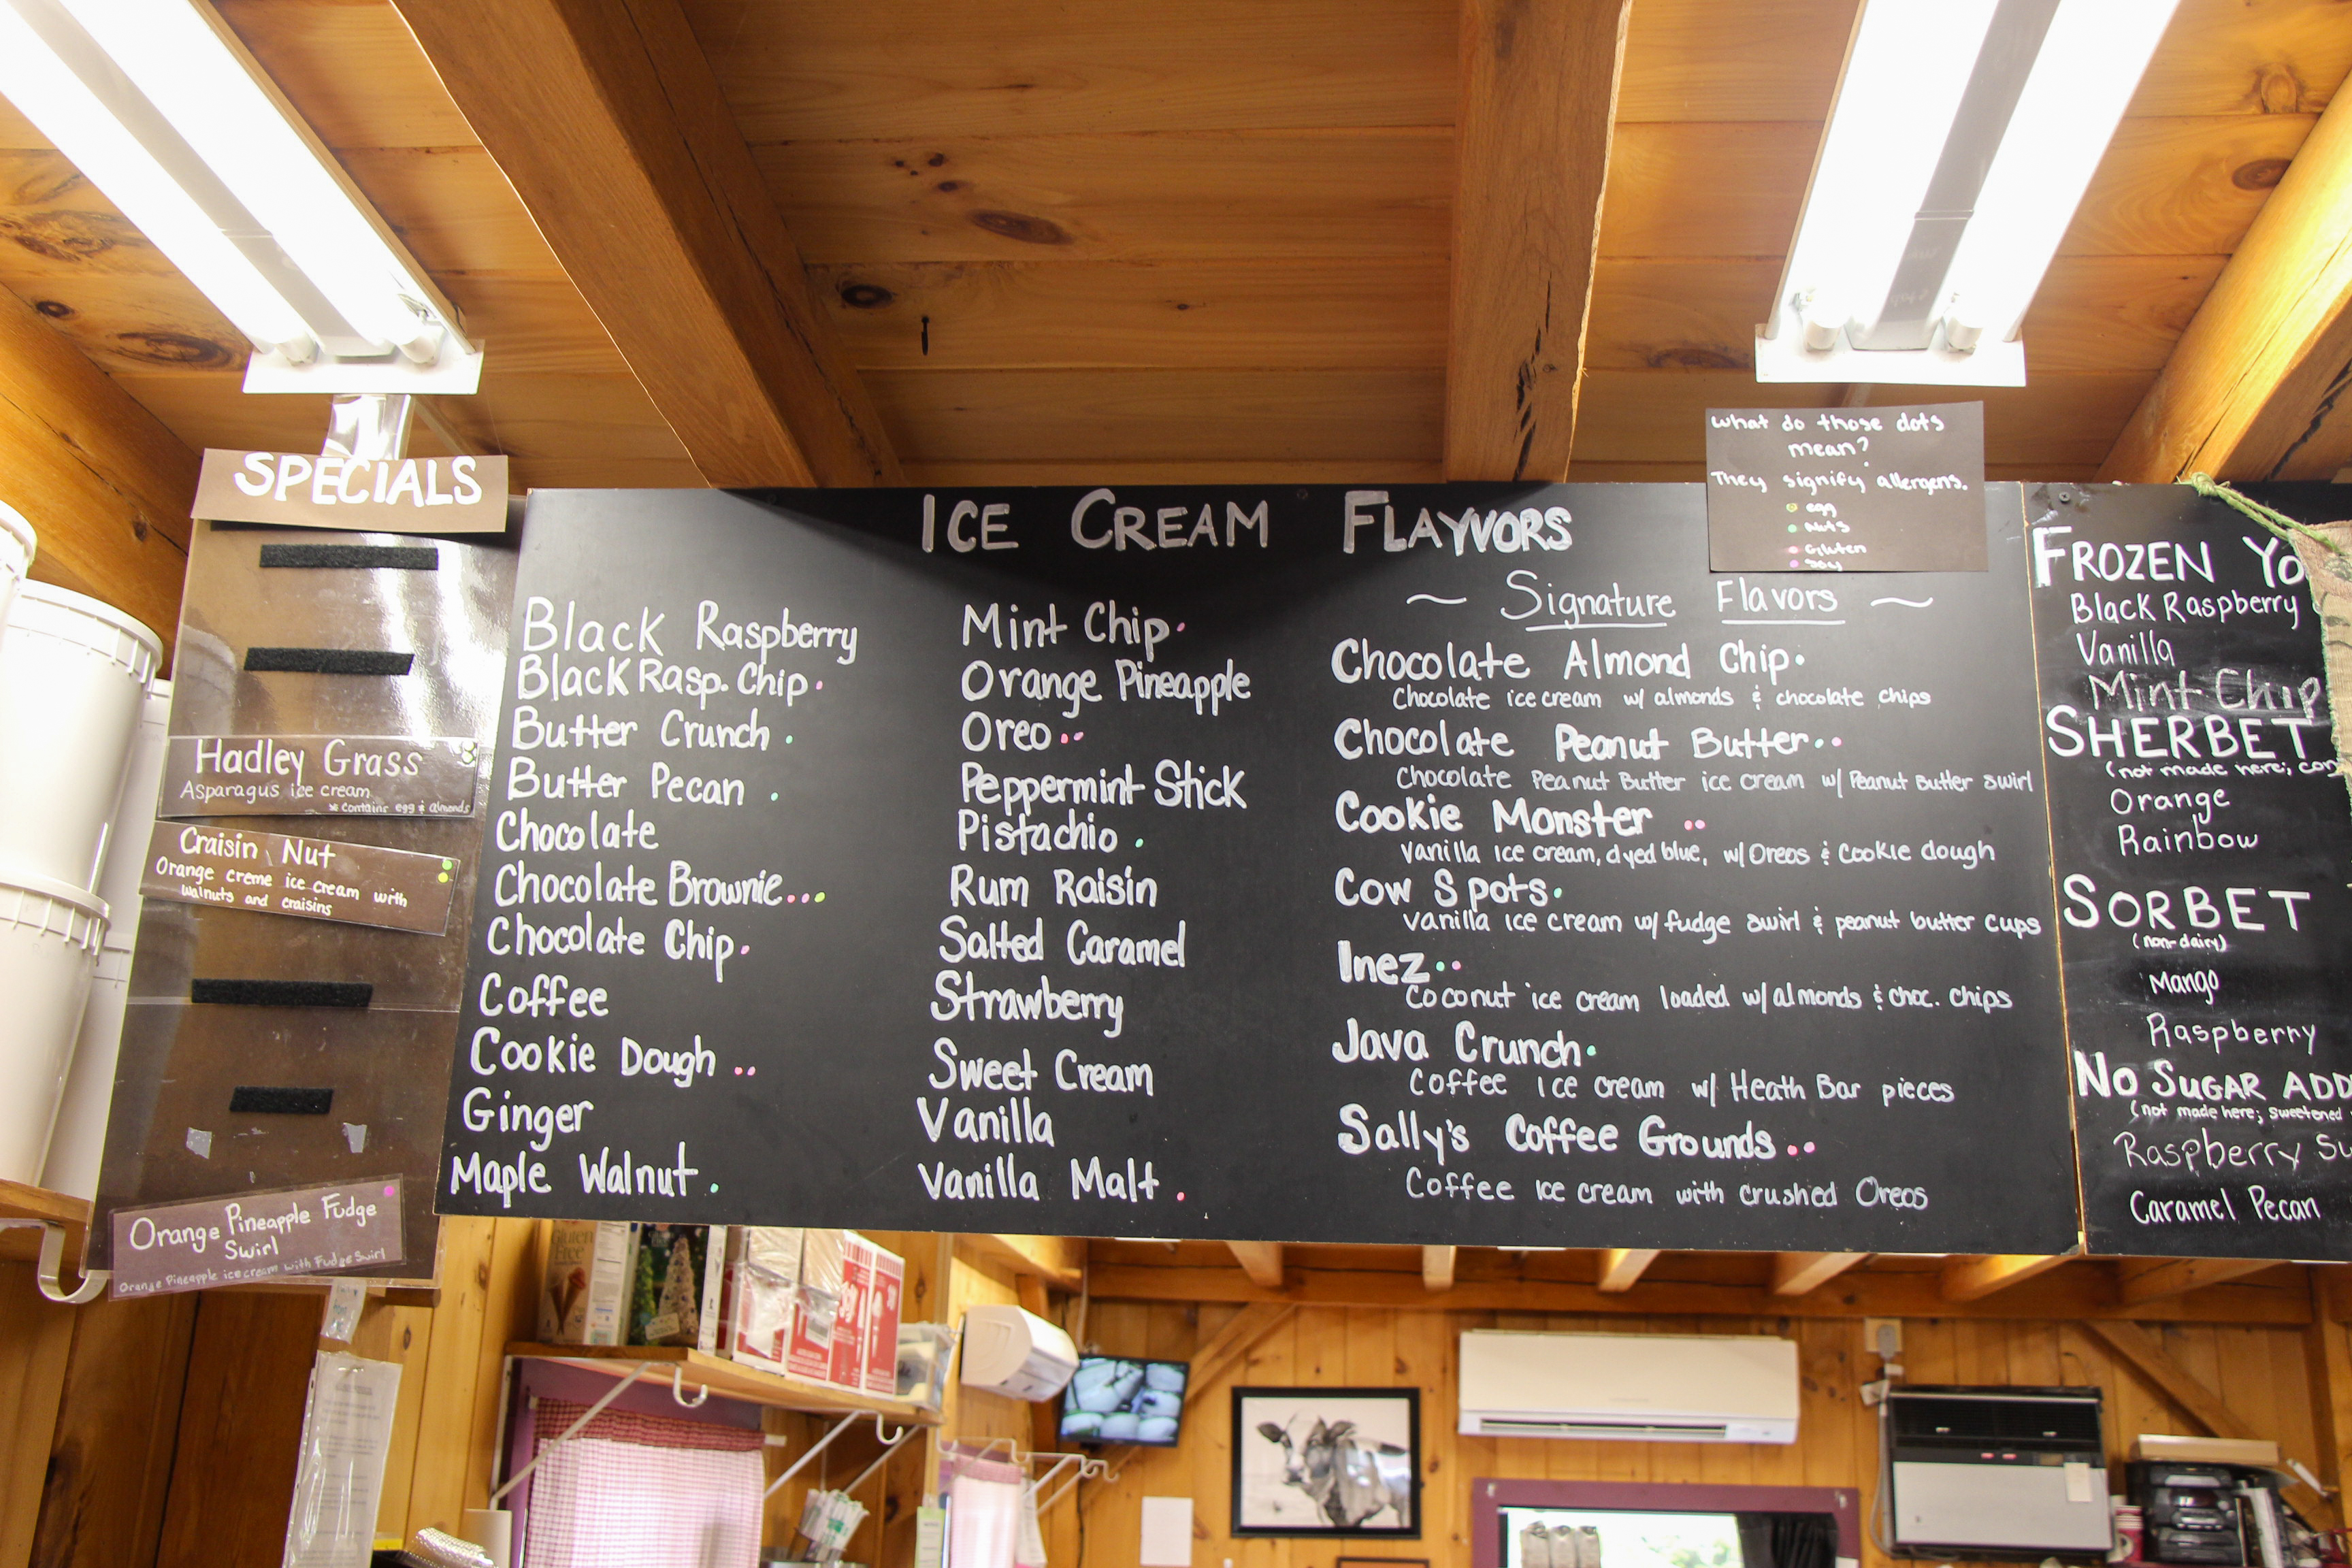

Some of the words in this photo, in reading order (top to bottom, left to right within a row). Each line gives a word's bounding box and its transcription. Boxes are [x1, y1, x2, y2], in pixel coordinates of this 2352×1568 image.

[1782, 414, 1805, 431] do
[1817, 414, 1882, 431] those
[1897, 412, 1944, 431] dots
[1788, 437, 1869, 467] mean?
[234, 452, 483, 506] SPECIALS
[1711, 471, 1767, 493] They
[1783, 470, 1865, 495] signify
[1877, 472, 1967, 495] allergens.
[922, 494, 1019, 553] ICE
[1071, 489, 1268, 551] CREAM
[1806, 503, 1837, 518] egg
[2032, 526, 2214, 588] FROZEN
[1501, 570, 1676, 631] Signature
[1717, 576, 1838, 612] Flavors
[2071, 592, 2155, 624] Black
[2163, 590, 2298, 630] Raspberry
[523, 596, 664, 656] Black
[696, 600, 857, 665] Raspberry
[963, 603, 1067, 651] Mint
[1085, 600, 1169, 662] Chip
[2076, 630, 2174, 666] Vanilla
[1332, 638, 1531, 683] Chocolate
[1564, 638, 1691, 679] Almond
[1720, 639, 1789, 685] Chip
[640, 658, 728, 710] Rasp.
[738, 661, 808, 706] Chip
[962, 660, 1102, 718] Orange
[1115, 659, 1251, 716] Pineapple
[1507, 689, 1536, 707] ice
[1542, 691, 1601, 708] cream
[1654, 687, 1734, 706] almonds
[1776, 687, 1864, 706] chocolate
[1879, 687, 1931, 708] chips
[2089, 670, 2202, 711] Mint
[2216, 668, 2320, 719] Chip
[512, 706, 638, 749] Butter
[661, 708, 770, 751] Crunch
[962, 712, 1051, 751] Oreo
[1335, 719, 1514, 760] Chocolate
[1556, 723, 1669, 762] Peanut
[1691, 728, 1809, 759] Butter
[2046, 704, 2314, 759] SHERBET
[196, 738, 304, 786] Hadley
[325, 738, 423, 777] Grass
[508, 756, 627, 800] Butter
[652, 762, 744, 806] Pecan
[1531, 770, 1610, 791] Peanut
[1618, 771, 1686, 791] Butter
[1702, 771, 1731, 791] ice
[1740, 774, 1804, 791] cream
[1849, 770, 1908, 790] Peanut
[1915, 770, 1973, 791] Butter
[1984, 770, 2033, 791] swirl
[2160, 763, 2227, 776] made
[180, 780, 279, 804] Asparagus
[291, 783, 313, 799] ice
[321, 785, 372, 798] cream
[429, 800, 470, 813] almonds
[962, 762, 1145, 817] Peppermint
[1154, 760, 1247, 809] Stick
[2110, 789, 2230, 824] Orange
[497, 807, 659, 851] Chocolate
[958, 808, 1117, 855] Pistachio
[1336, 791, 1463, 833] Cookie
[1492, 798, 1653, 837] Monster
[2119, 813, 2257, 856] Rainbow
[180, 826, 258, 859] Craisin
[282, 838, 336, 868] Nut
[1606, 843, 1656, 869] dyed
[1921, 840, 1995, 869] dough
[157, 856, 214, 885] Orange
[226, 869, 272, 887] creme
[286, 872, 306, 890] ice
[312, 881, 359, 900] cream
[374, 888, 407, 907] with
[495, 860, 657, 906] Chocolate
[669, 860, 782, 906] Brownie
[951, 864, 1028, 907] Rum
[1054, 866, 1157, 906] Raisin
[1335, 868, 1411, 906] Cow
[1435, 868, 1548, 912] Spots
[2063, 874, 2310, 930] SORBET
[245, 894, 268, 906] and
[282, 897, 332, 916] craisins
[1548, 913, 1622, 932] cream
[1664, 910, 1731, 944] fudge
[1835, 910, 1900, 938] peanut
[1910, 911, 1975, 931] butter
[488, 911, 644, 956] Chocolate
[665, 919, 734, 983] Chip
[939, 915, 1043, 963] Salted
[1067, 919, 1186, 967] Caramel
[1338, 941, 1430, 985] Inez
[480, 973, 608, 1017] Coffee
[931, 970, 1124, 1038] Strawberry
[1525, 983, 1562, 1009] ice
[1576, 991, 1639, 1012] cream
[1660, 984, 1730, 1009] loaded
[1950, 985, 2012, 1013] chips
[2149, 970, 2219, 1004] Mango
[1333, 1018, 1429, 1062] Java
[1456, 1021, 1581, 1068] Crunch
[2146, 1012, 2315, 1055] Raspberry
[471, 1027, 595, 1075] Cookie
[621, 1035, 715, 1088] Dough
[929, 1037, 1038, 1091] Sweet
[1056, 1049, 1153, 1096] Cream
[1595, 1076, 1665, 1098] cream
[1731, 1069, 1806, 1102] Heath
[1816, 1074, 1861, 1099] Bar
[1882, 1077, 1954, 1107] pieces
[463, 1087, 593, 1152] Ginger
[917, 1097, 1054, 1147] Vanilla
[1338, 1104, 1469, 1166] Sally's
[1505, 1113, 1618, 1154] Coffee
[1639, 1115, 1776, 1159] Grounds
[2177, 1105, 2217, 1120] made
[2269, 1105, 2342, 1121] sweetened
[2113, 1128, 2300, 1171] Raspberry
[451, 1151, 551, 1208] Maple
[579, 1141, 698, 1197] Walnut
[917, 1153, 1039, 1200] Vanilla
[1071, 1156, 1159, 1203] Malt
[1578, 1183, 1652, 1205] cream
[1676, 1181, 1724, 1205] with
[1856, 1176, 1928, 1210] Oreos
[130, 1218, 220, 1253] Orange
[225, 1202, 310, 1235] Pineapple
[321, 1193, 377, 1227] Fudge
[2130, 1188, 2236, 1224] Caramel
[2248, 1185, 2320, 1220] Pecan
[225, 1236, 278, 1260] Swirl
[120, 1281, 161, 1292] Orange
[166, 1268, 218, 1287] Pineapple
[284, 1258, 311, 1271] with
